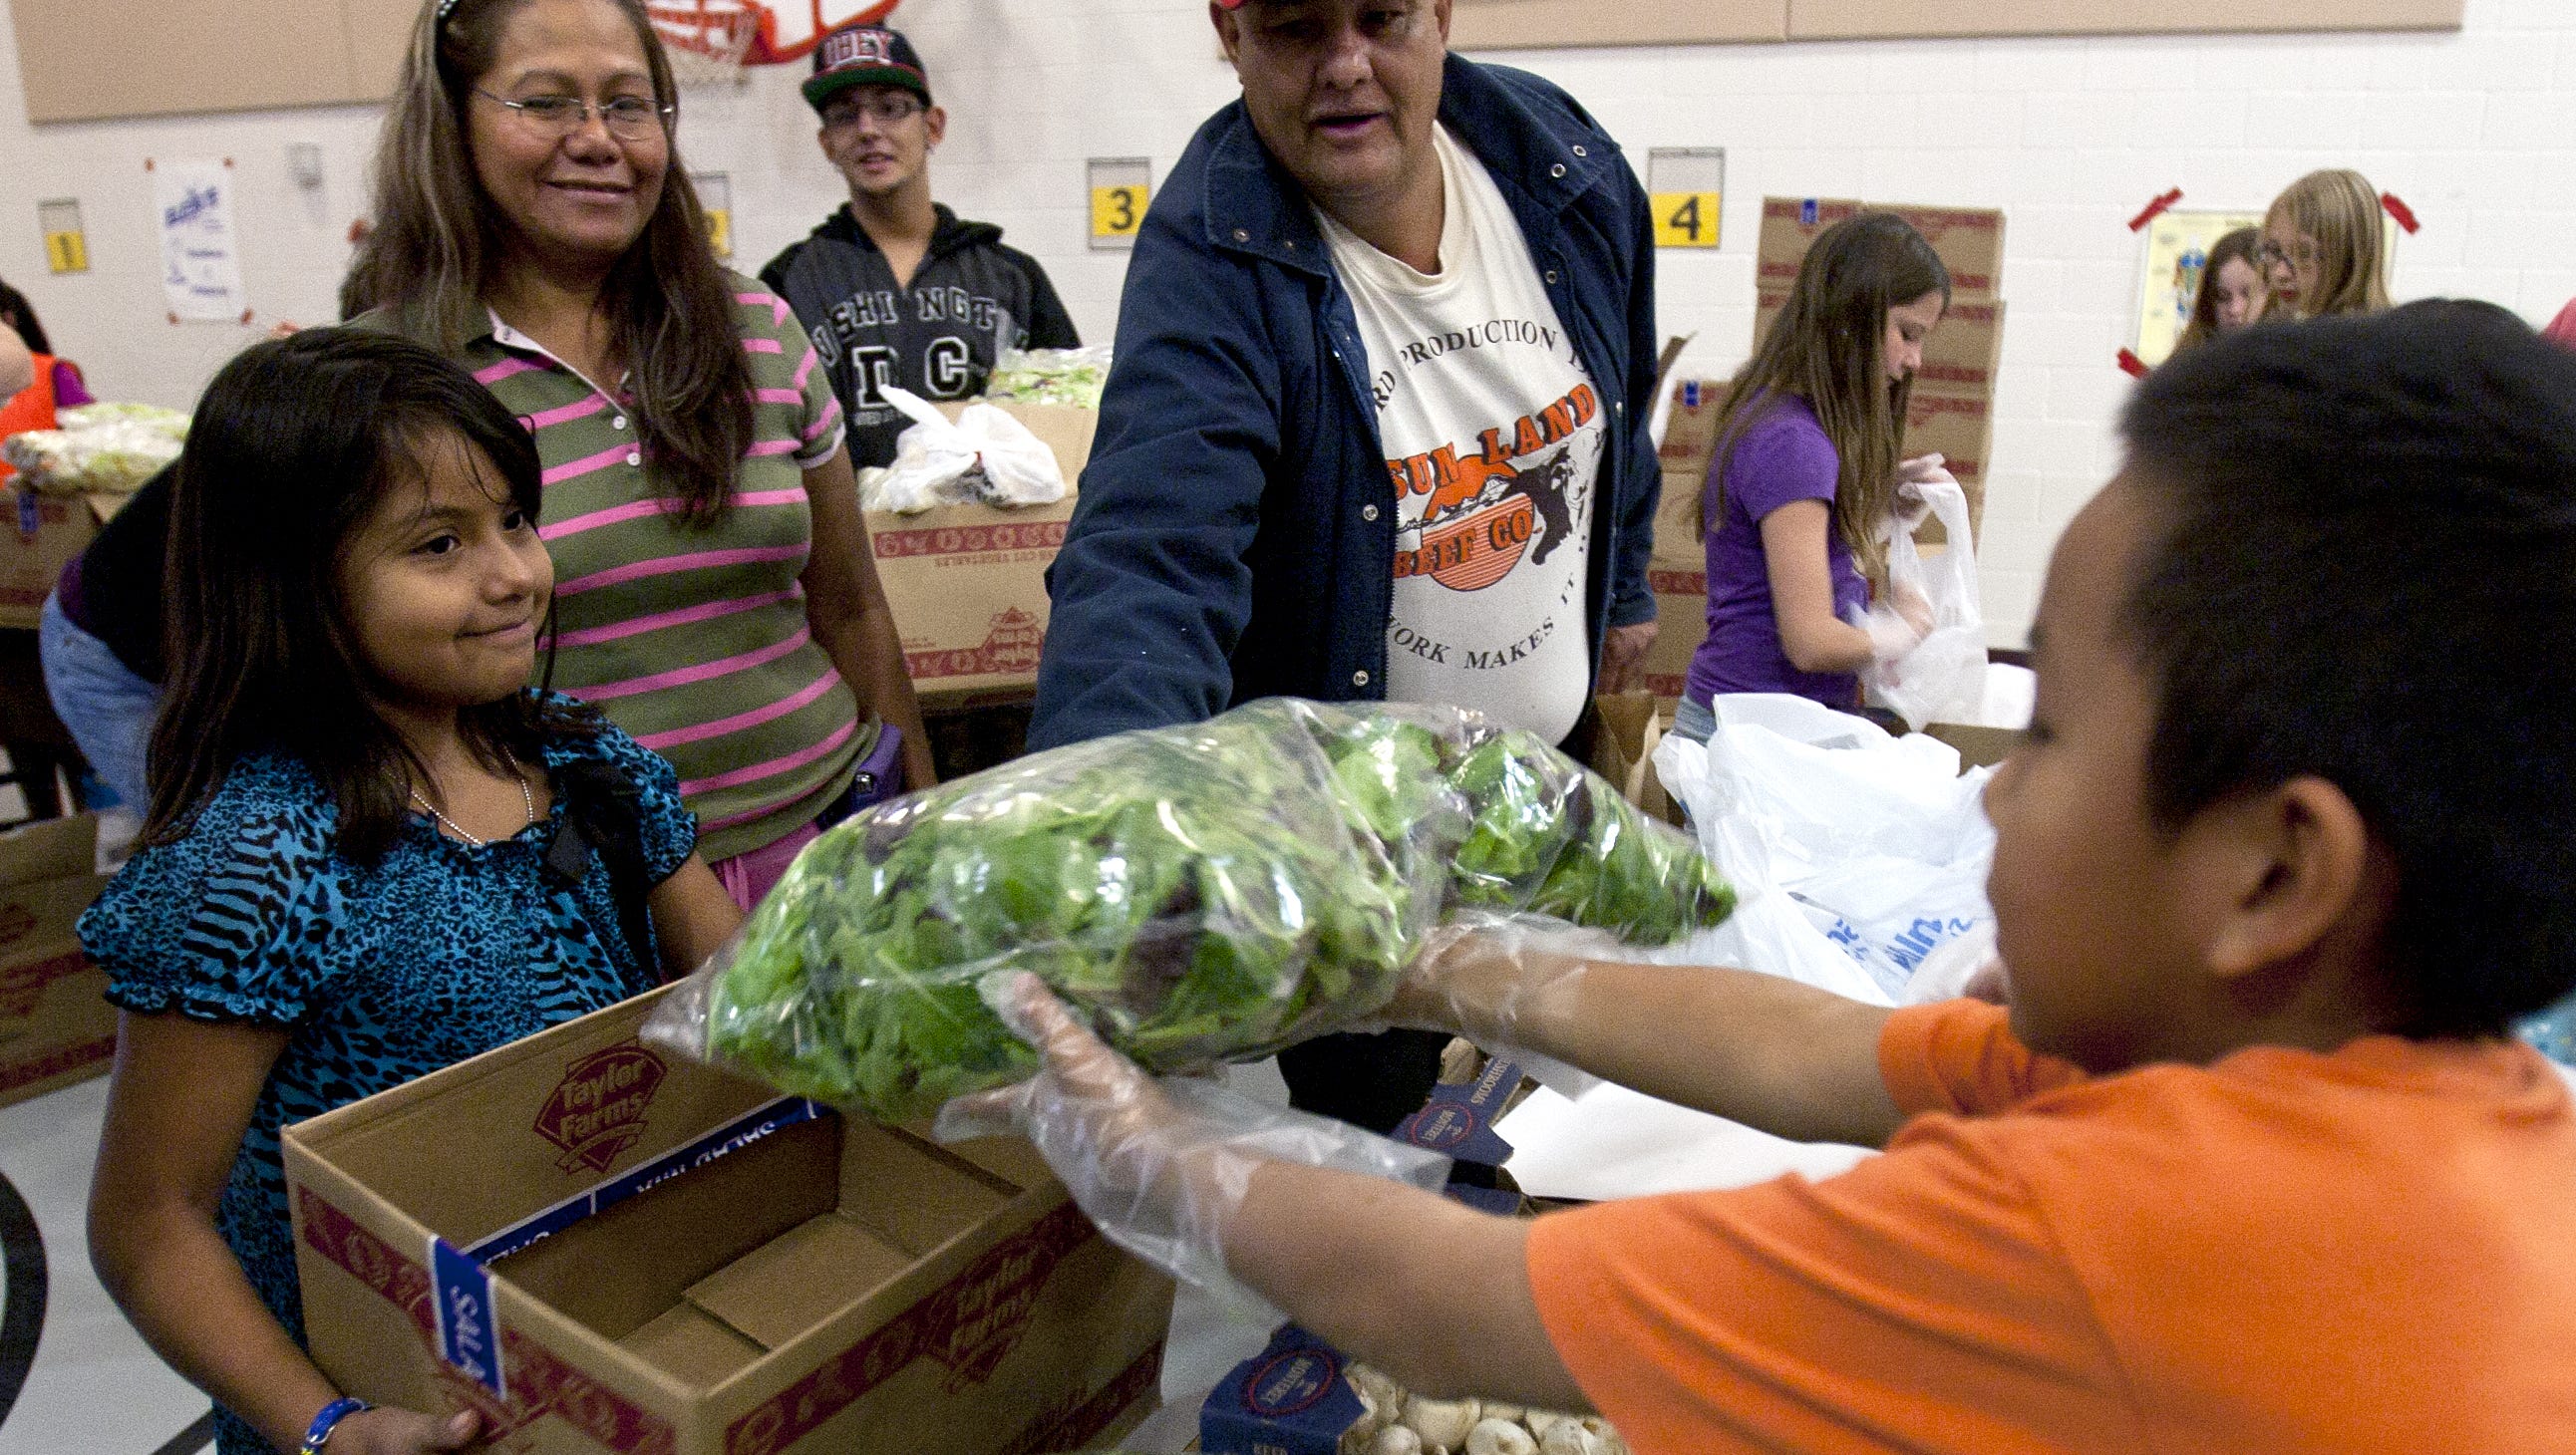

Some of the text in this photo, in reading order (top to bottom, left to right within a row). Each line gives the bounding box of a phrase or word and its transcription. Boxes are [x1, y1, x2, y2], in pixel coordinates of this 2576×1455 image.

[1109, 186, 1133, 230] 3
[1669, 194, 1702, 241] 4
[925, 335, 968, 397] C
[1385, 383, 1596, 501] SUN LAND
[1393, 528, 1477, 579] BEEF
[1462, 615, 1554, 670] MAKES
[559, 1056, 647, 1111] Taylor
[560, 1092, 646, 1144] Farms
